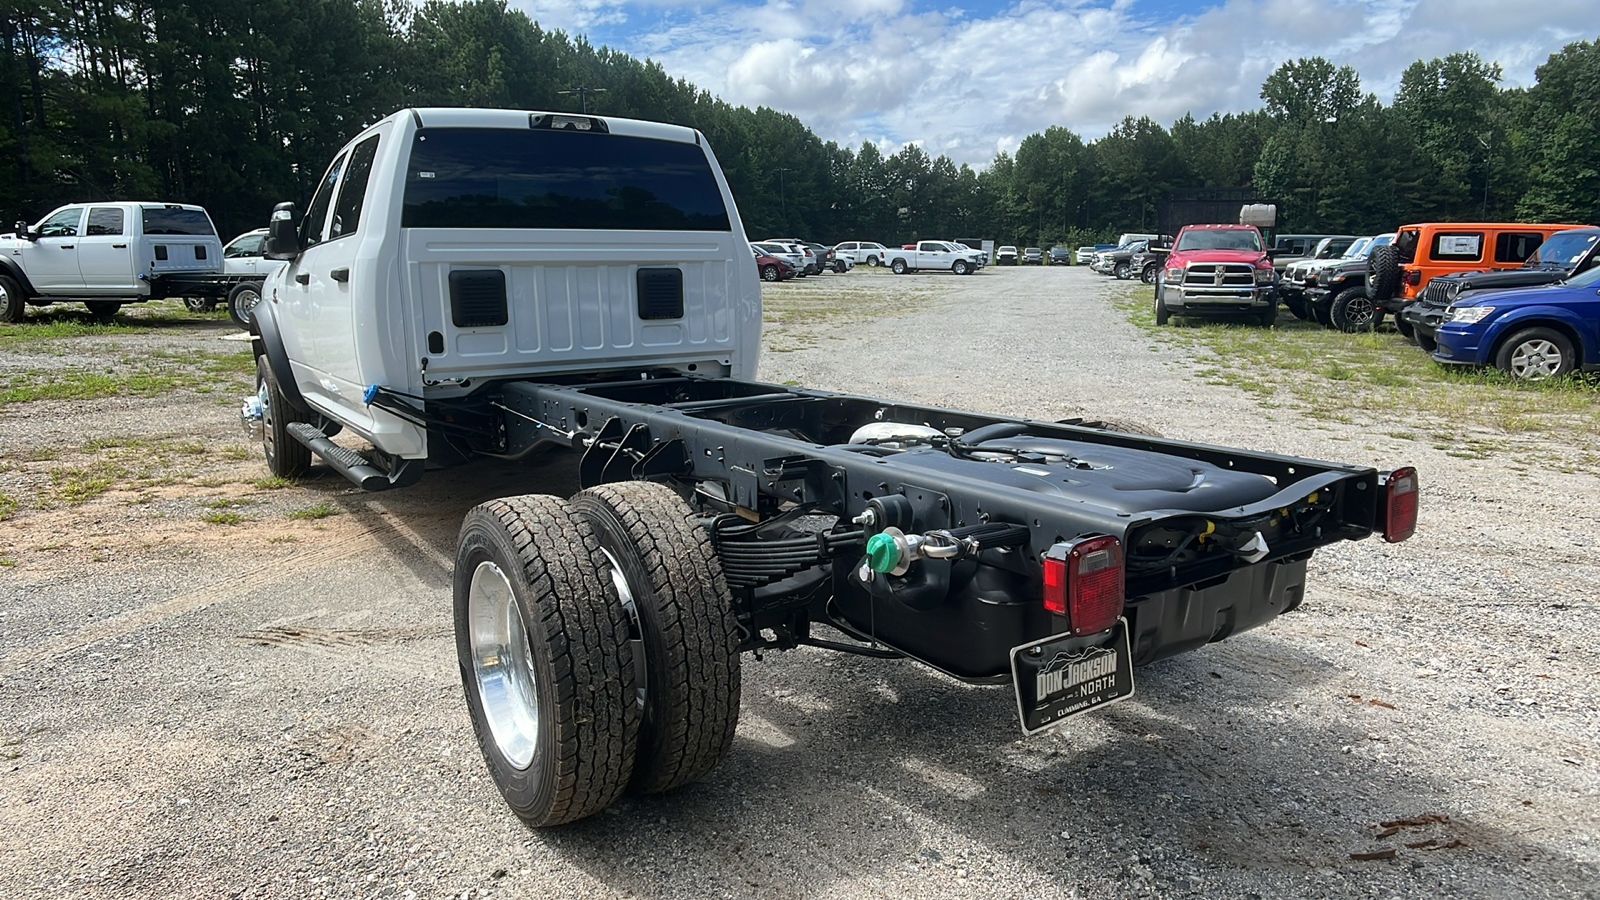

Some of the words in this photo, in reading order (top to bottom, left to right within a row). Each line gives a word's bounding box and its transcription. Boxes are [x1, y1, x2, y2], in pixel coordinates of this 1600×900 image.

[1036, 669, 1063, 702] DON
[1063, 652, 1117, 689] JACKSON
[1080, 675, 1115, 697] NORTH
[1091, 696, 1102, 704] GA
